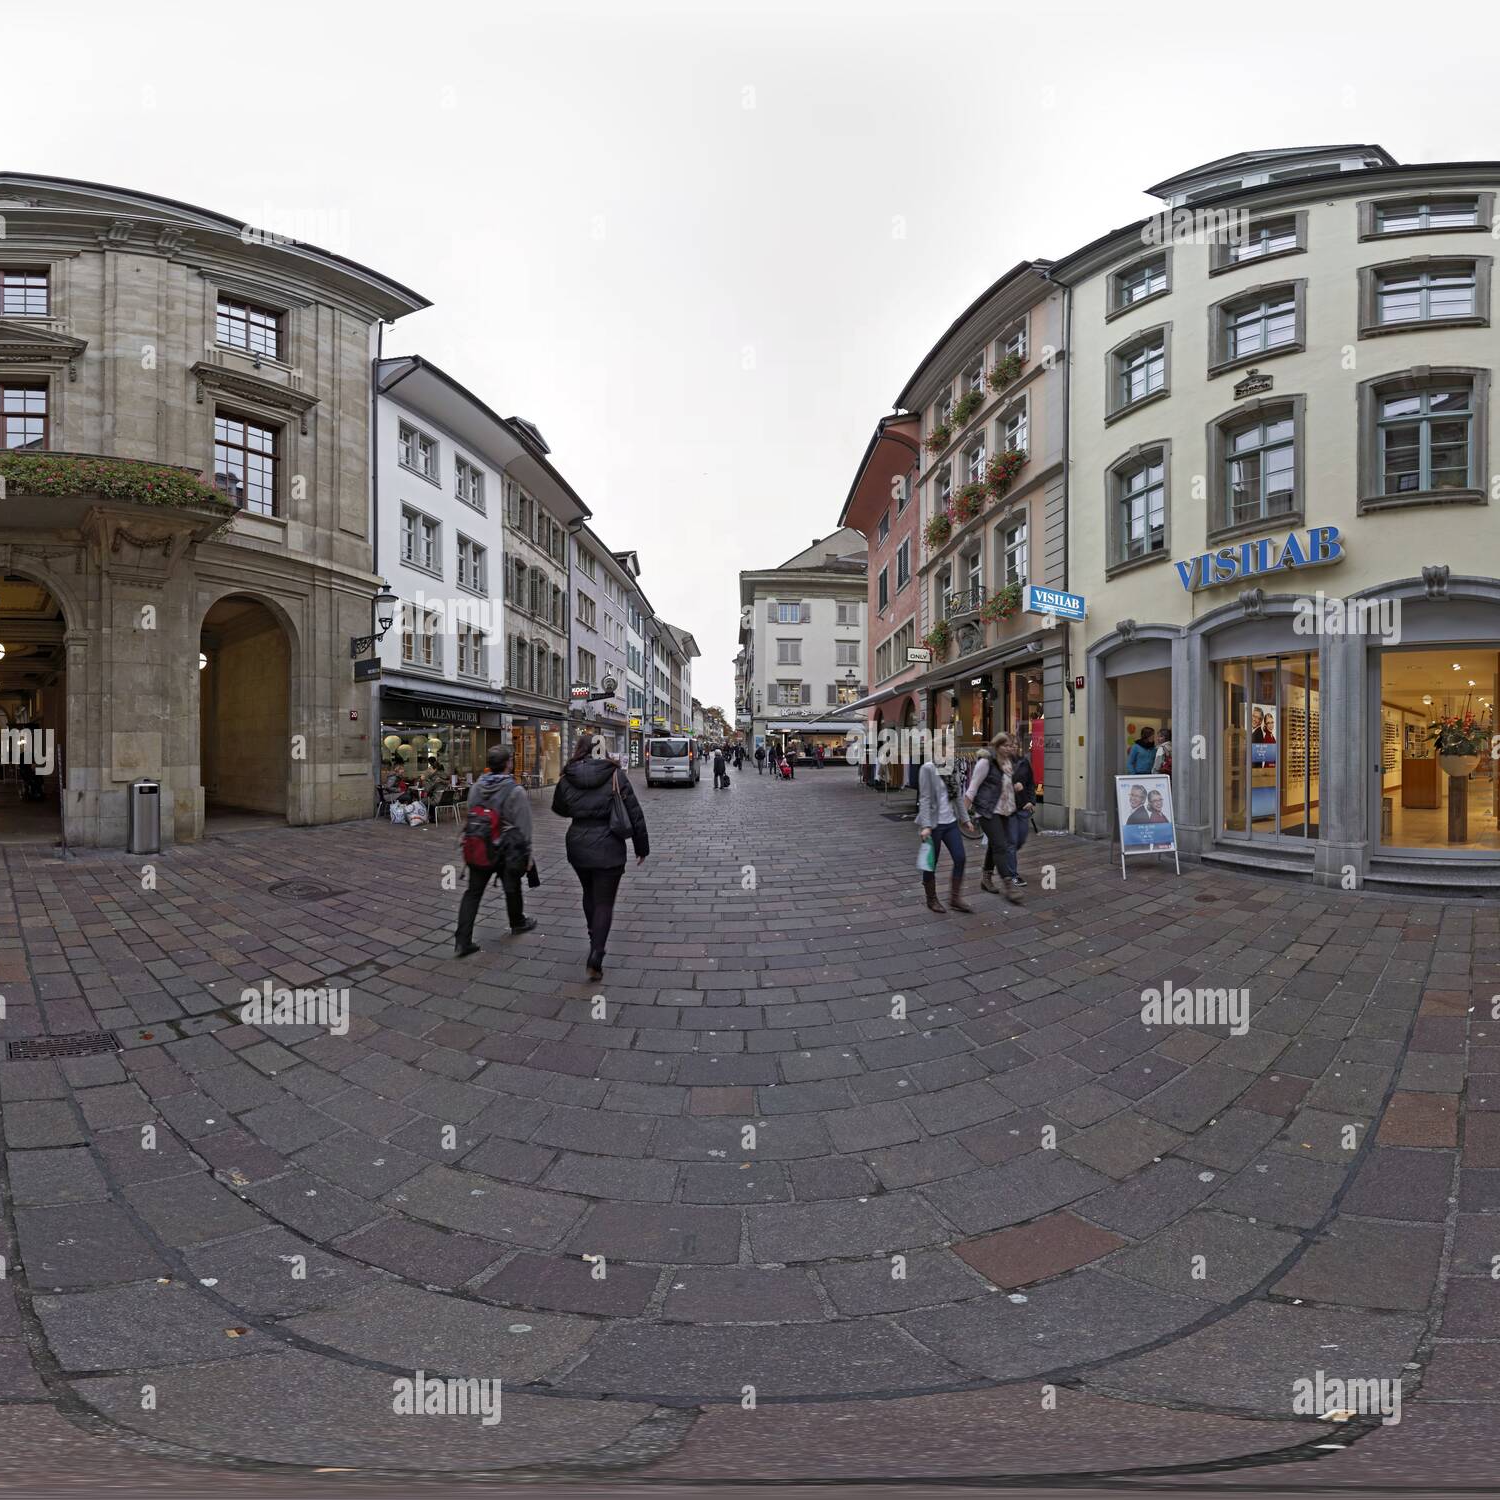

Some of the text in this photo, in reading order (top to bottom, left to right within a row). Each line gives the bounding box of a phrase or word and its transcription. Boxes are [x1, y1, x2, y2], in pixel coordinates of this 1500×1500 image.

[1174, 526, 1343, 592] VISILAB
[1035, 590, 1080, 609] VISILAB
[421, 706, 478, 722] VOLLENWEIDER
